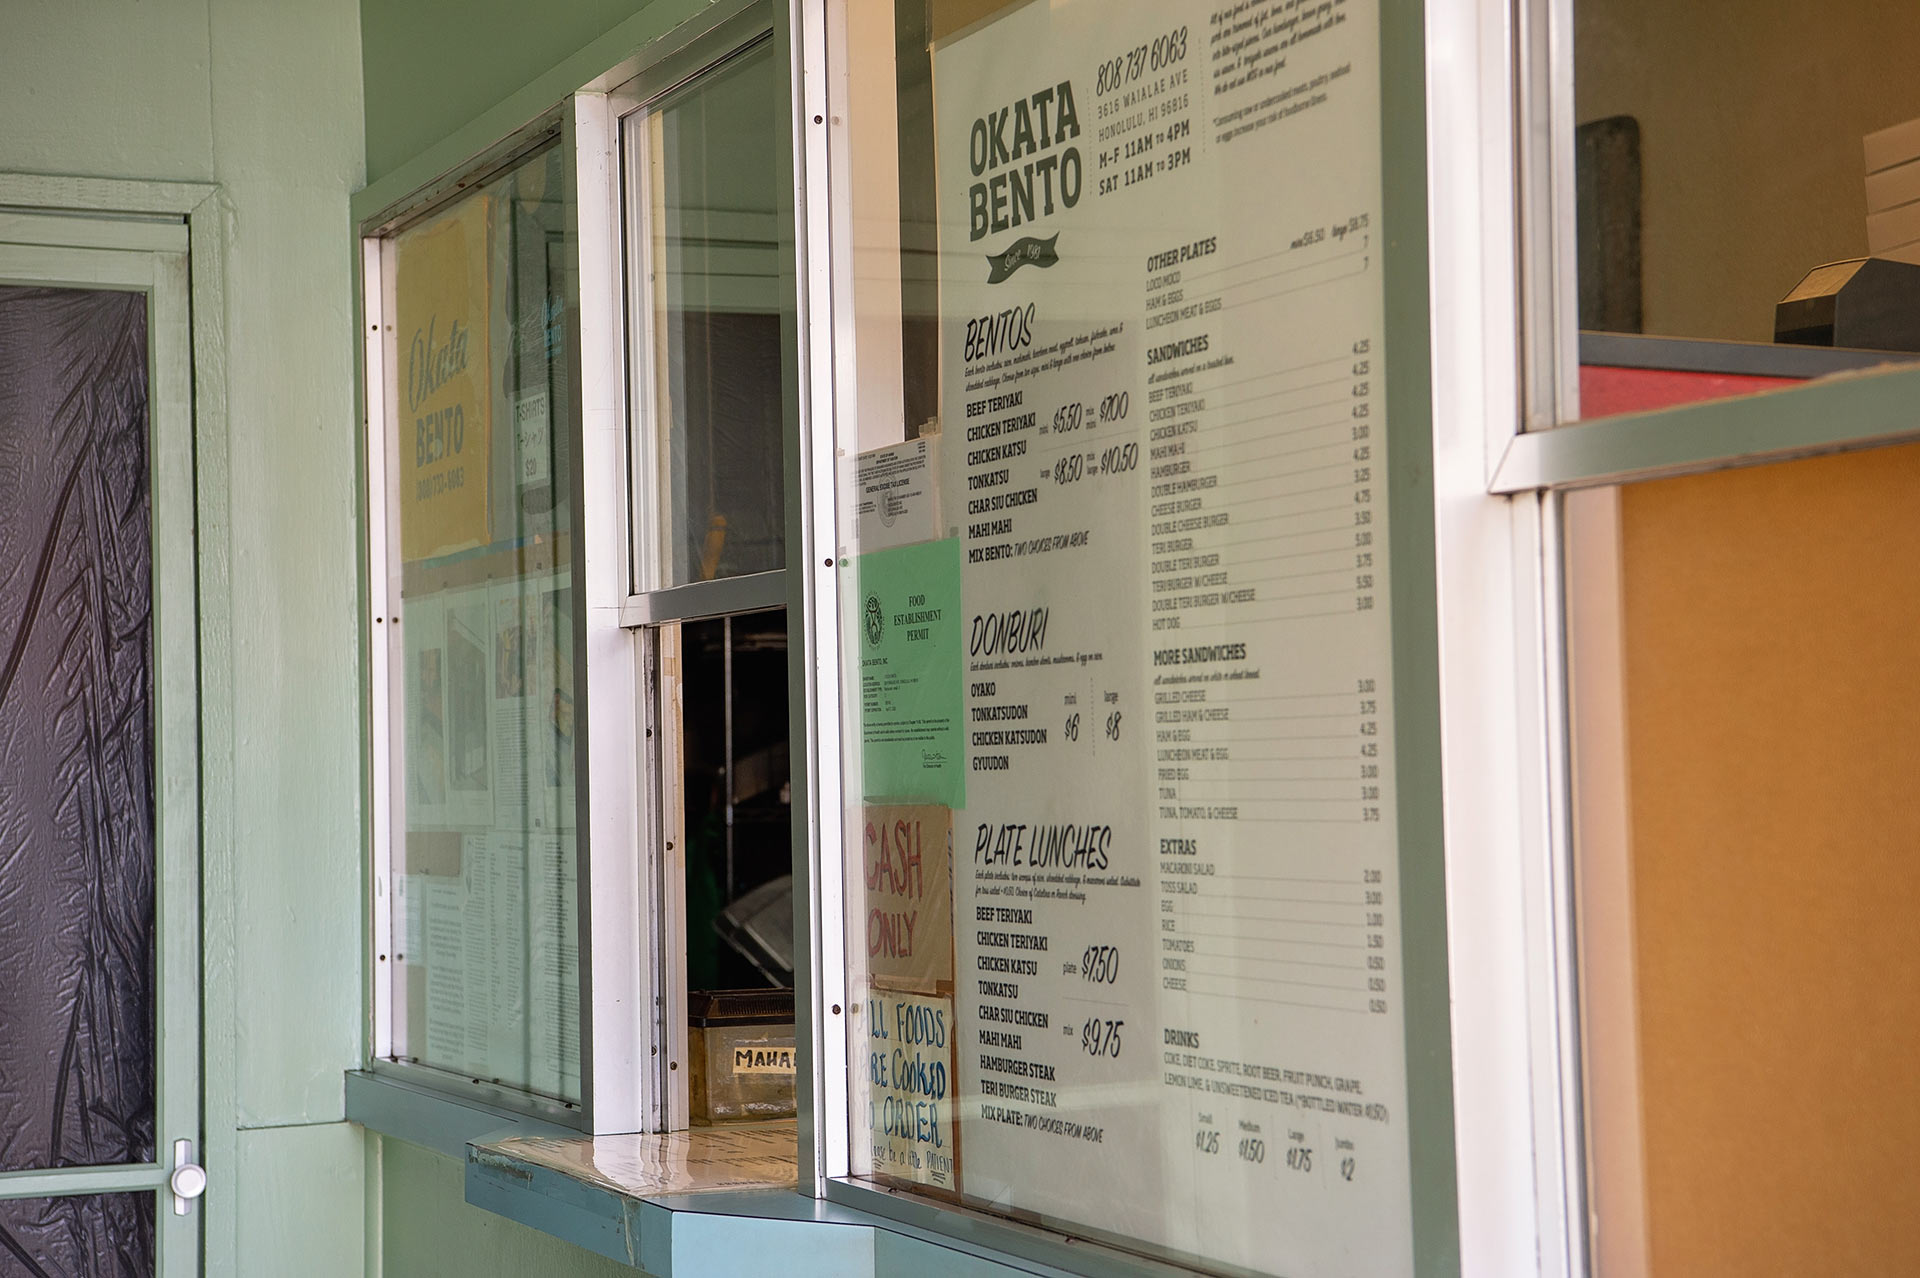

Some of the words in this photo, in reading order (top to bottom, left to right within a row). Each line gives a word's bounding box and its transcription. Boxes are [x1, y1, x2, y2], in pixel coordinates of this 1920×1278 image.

[1097, 57, 1122, 96] 808
[1126, 45, 1147, 84] 737
[1151, 26, 1187, 72] 6063
[1098, 99, 1119, 119] 3616
[1123, 79, 1165, 108] WAIALAE
[1169, 69, 1187, 90] AVE
[970, 80, 1080, 176] OKATA
[1099, 115, 1145, 142] HONOLULU,
[1149, 107, 1158, 122] HI
[1161, 94, 1188, 118] 96816
[1100, 147, 1119, 169] M-F
[1125, 134, 1152, 159] 11AM
[1167, 119, 1189, 141] 4PM
[1099, 174, 1118, 195] SAT
[1125, 161, 1153, 186] 11AM
[1168, 147, 1191, 170] 3PM
[970, 147, 1082, 242] BENTO
[1004, 250, 1021, 271] Since
[1147, 249, 1178, 272] OTHER
[1180, 237, 1216, 262] PLATES
[964, 302, 1035, 362] BENTOS
[408, 312, 468, 413] Okata
[1147, 334, 1208, 365] SANDWICHES
[516, 397, 544, 422] T-SHIRTS
[967, 401, 986, 418] BEEF
[988, 391, 1022, 412] TERIYAKI
[1053, 403, 1082, 433] $5.50
[416, 403, 464, 468] BENTO
[967, 423, 1000, 442] CHICKEN
[1002, 412, 1035, 434] TERIYAKI
[968, 449, 1001, 466] CHICKEN
[1002, 440, 1027, 459] KATSU
[1101, 442, 1138, 476] $10.50
[968, 469, 1009, 490] TONKATSU
[1054, 454, 1083, 485] $8.50
[968, 497, 990, 515] CHAR
[992, 495, 1004, 510] SIU
[1005, 488, 1037, 508] CHICKEN
[968, 522, 990, 539] MAHI
[991, 519, 1012, 535] MAHI
[969, 548, 984, 563] MIX
[985, 544, 1013, 561] BENTO:
[1014, 541, 1027, 557] TWO
[1028, 537, 1051, 555] CHOICES
[1052, 534, 1068, 550] FROM
[1070, 530, 1089, 547] ABOVE
[909, 595, 925, 607] FOOD
[894, 609, 941, 626] ESTABLISHMENT
[970, 607, 1049, 657] DONBURI
[907, 628, 929, 641] PERMIT
[1154, 649, 1181, 666] MORE
[1182, 643, 1246, 664] SANDWICHES
[971, 682, 996, 697] OYAKO
[972, 705, 1028, 722] TONKATSUDON
[1065, 713, 1080, 741] $6
[1106, 711, 1122, 741] $8
[972, 732, 1004, 746] CHICKEN
[1005, 729, 1047, 744] KATSUDON
[973, 756, 1009, 771] GYUUDON
[863, 819, 922, 902] CASH
[975, 823, 1027, 866] PLATE
[1029, 824, 1111, 870] LUNCHES
[1160, 839, 1196, 855] EXTRAS
[977, 906, 994, 921] BEEF
[996, 908, 1032, 924] TERIYAKI
[868, 907, 918, 959] ONLY
[977, 931, 1009, 948] CHICKEN
[1011, 934, 1048, 951] TERIYAKI
[978, 956, 1010, 973] CHICKEN
[1011, 959, 1037, 976] KATSU
[1081, 945, 1118, 984] $7.50
[978, 981, 1018, 999] TONKATSU
[870, 1000, 888, 1039] LL
[896, 1002, 944, 1048] FOODS
[979, 1005, 1000, 1021] CHAR
[1001, 1008, 1013, 1023] SIU
[1015, 1010, 1048, 1028] CHICKEN
[979, 1030, 999, 1047] MAHI
[1001, 1033, 1022, 1050] MAHI
[1082, 1018, 1124, 1058] $9.75
[1164, 1029, 1199, 1048] DRINKS
[736, 1050, 796, 1068] MAHA
[871, 1052, 888, 1088] RE
[980, 1054, 1028, 1077] HAMBURGER
[1029, 1063, 1055, 1081] STEAK
[981, 1080, 998, 1096] TERI
[1000, 1082, 1029, 1102] BURGER
[1031, 1088, 1056, 1108] STEAK
[884, 1096, 942, 1148] ORDER
[981, 1104, 996, 1121] MIX
[997, 1107, 1023, 1127] PLATE:
[1024, 1113, 1037, 1129] TWO
[1038, 1117, 1063, 1136] CHOICES
[1064, 1122, 1081, 1139] FROM
[1082, 1126, 1103, 1143] ABOVE
[871, 1139, 885, 1160] lease
[927, 1150, 952, 1171] PATIENT
